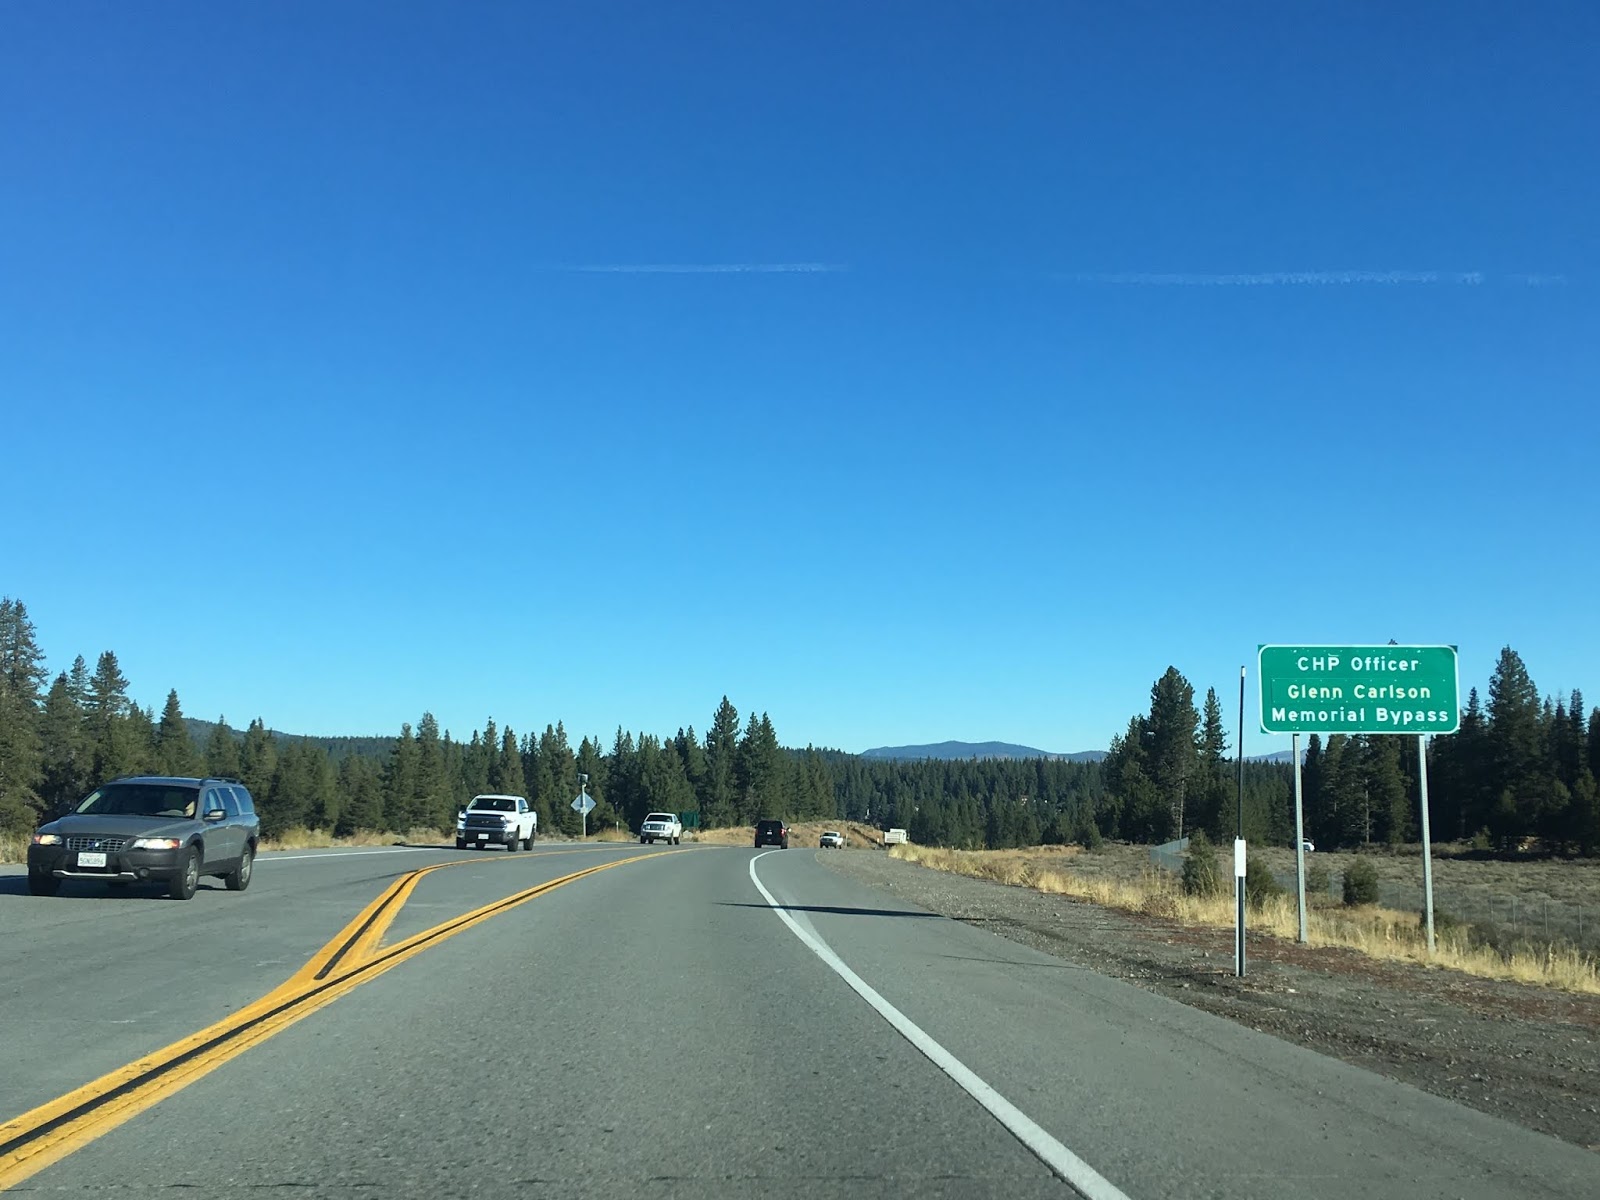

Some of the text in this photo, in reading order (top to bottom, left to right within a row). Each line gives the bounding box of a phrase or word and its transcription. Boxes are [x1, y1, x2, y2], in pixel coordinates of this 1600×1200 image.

[1297, 656, 1419, 671] CHP Officer
[1287, 684, 1431, 699] Glenn Carlson
[1272, 706, 1448, 725] Memorial Bypass
